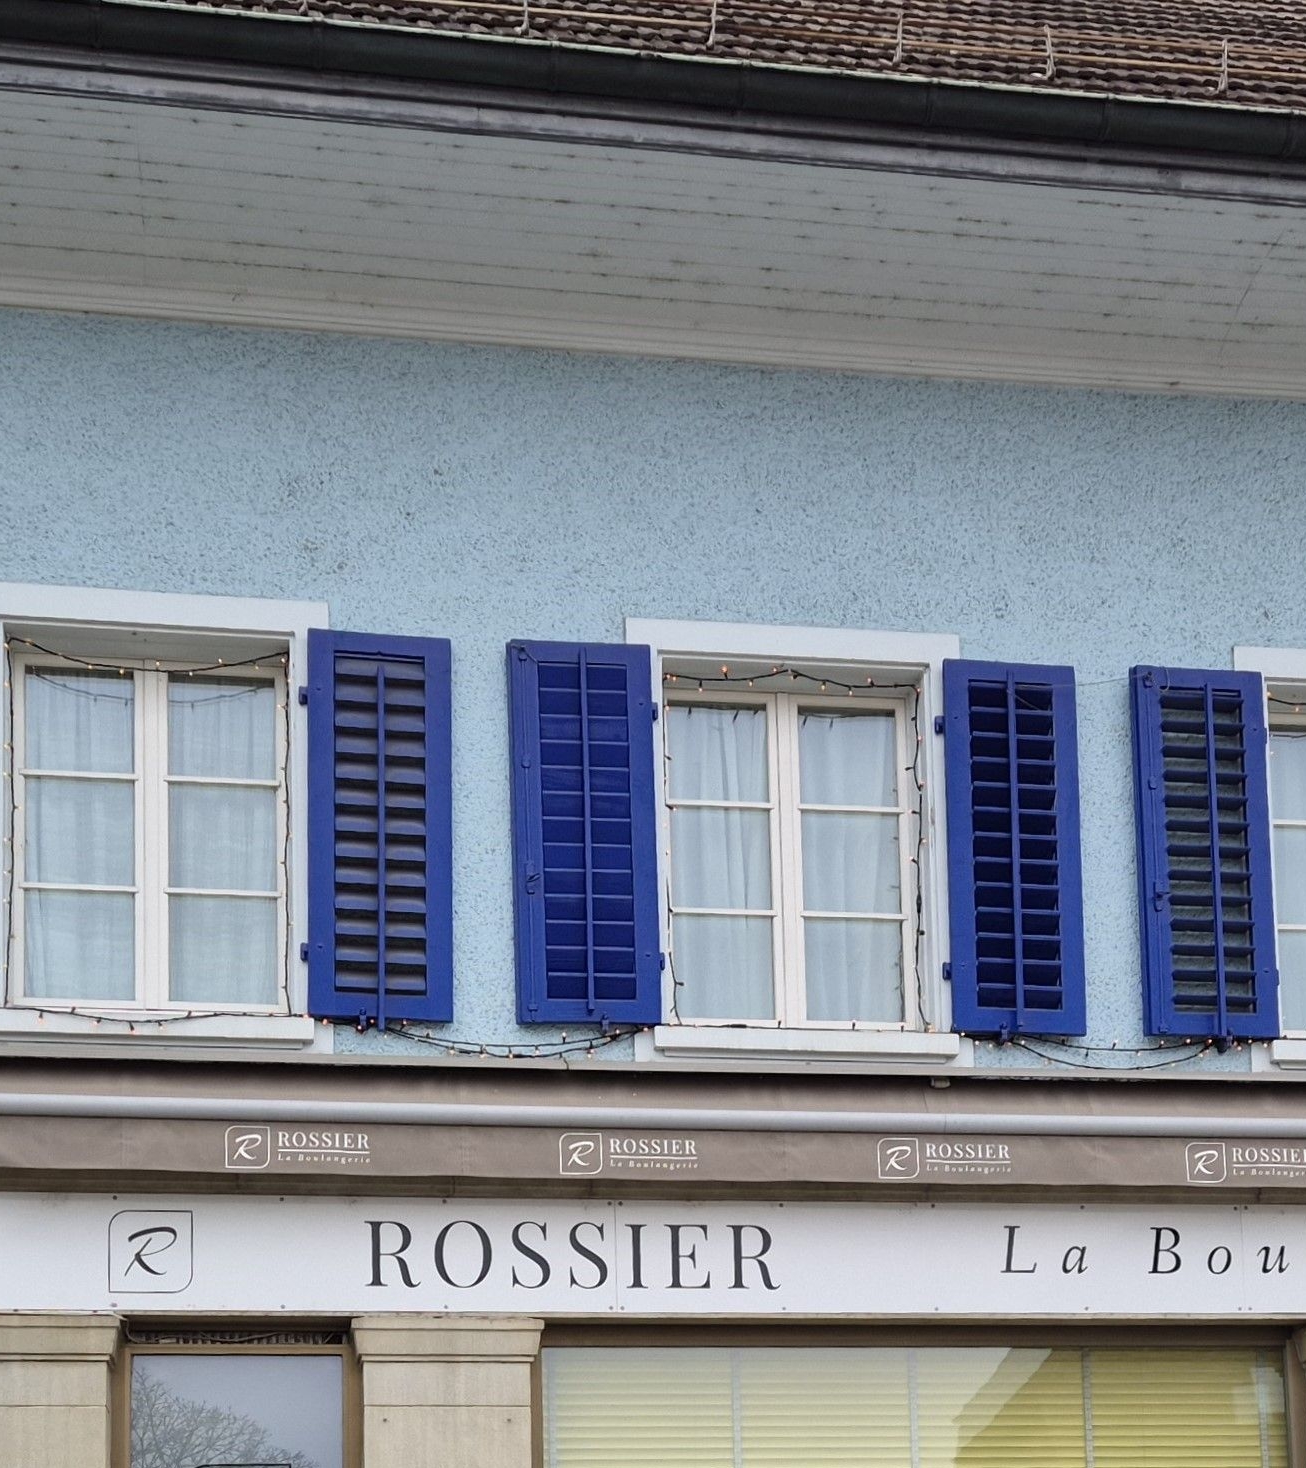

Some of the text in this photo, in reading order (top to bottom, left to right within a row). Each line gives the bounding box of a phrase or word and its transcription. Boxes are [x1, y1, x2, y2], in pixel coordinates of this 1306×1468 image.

[233, 1134, 262, 1160] R
[278, 1131, 369, 1149] ROSSIER
[609, 1138, 697, 1155] ROSSIER
[278, 1153, 370, 1164] La Boulangerie
[567, 1141, 595, 1166] R
[885, 1145, 912, 1171] R
[925, 1143, 1010, 1159] ROSSIER
[610, 1159, 698, 1170] La Boulangerie
[926, 1164, 1012, 1174] La Boulangerie
[1194, 1150, 1219, 1175] R
[1233, 1168, 1245, 1176] La
[125, 1226, 178, 1277] R
[365, 1219, 782, 1291] ROSSIER
[1001, 1224, 1089, 1276] La
